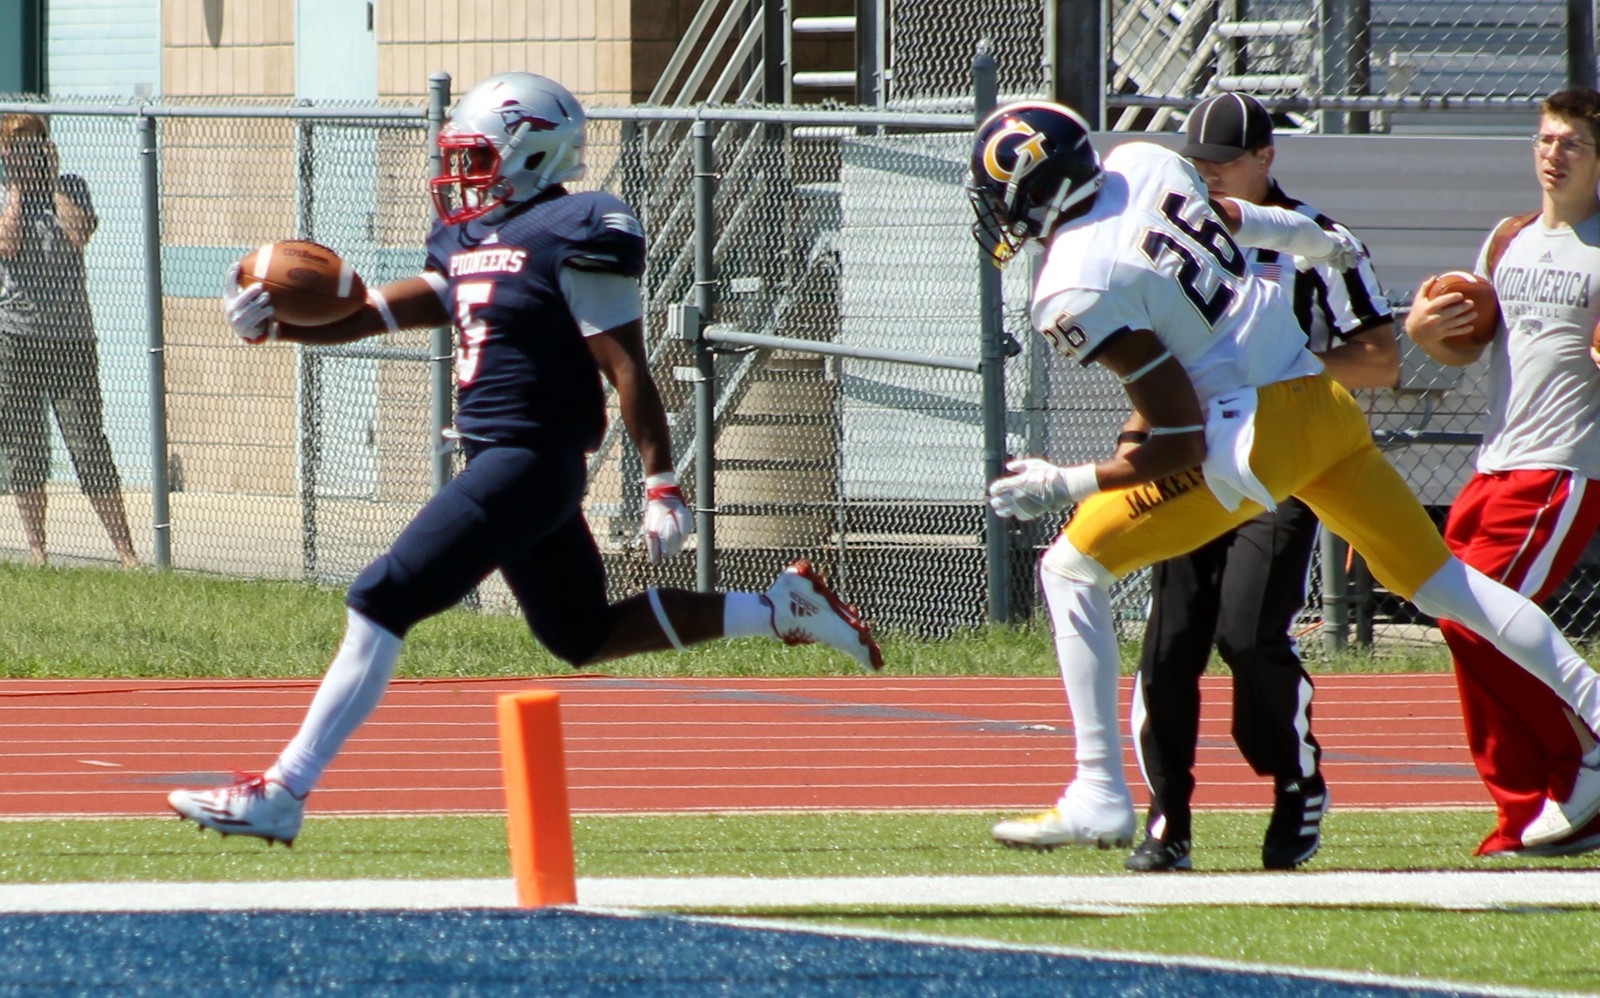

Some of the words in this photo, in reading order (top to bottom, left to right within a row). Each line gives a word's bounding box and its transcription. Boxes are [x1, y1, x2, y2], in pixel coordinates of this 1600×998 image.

[449, 248, 527, 276] PIONEERS
[1136, 190, 1248, 332] 26
[1497, 266, 1592, 309] MIDAMERICA
[455, 280, 495, 386] 5
